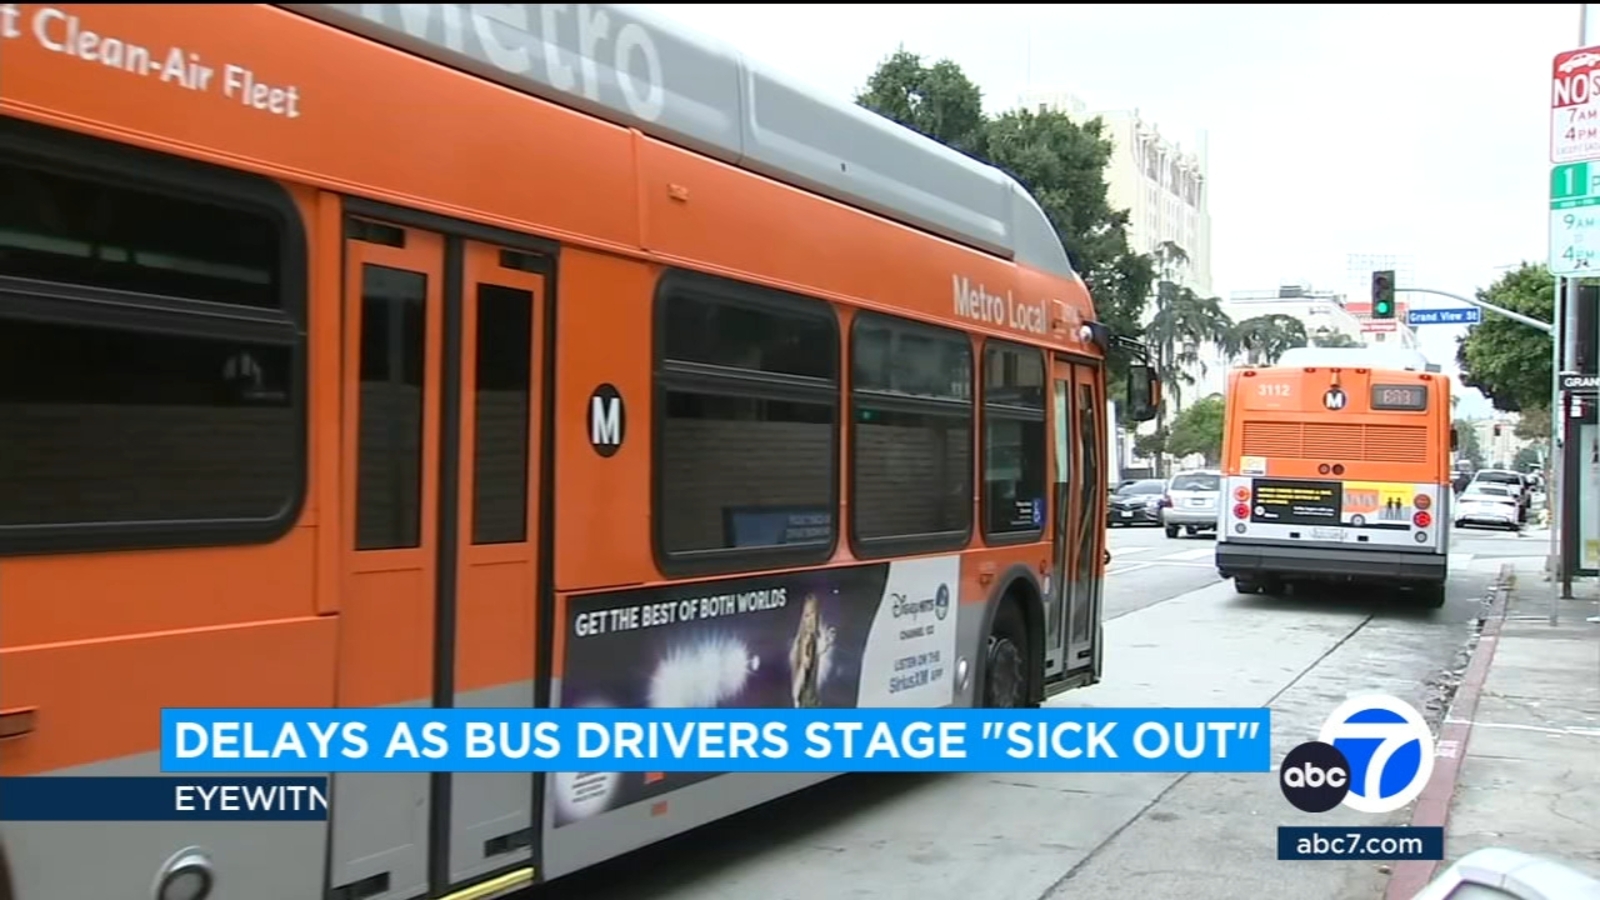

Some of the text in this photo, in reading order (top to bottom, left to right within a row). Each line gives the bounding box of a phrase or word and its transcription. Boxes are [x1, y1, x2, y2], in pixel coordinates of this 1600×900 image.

[32, 7, 214, 91] Clean-Air
[223, 63, 301, 118] Fleet
[1554, 73, 1589, 107] NO
[1563, 167, 1574, 196] 1
[952, 274, 1047, 335] Metro Local
[1409, 310, 1478, 323] Grand View St
[1257, 383, 1291, 397] 3112
[1325, 391, 1343, 409] M
[590, 393, 622, 447] M
[575, 588, 788, 636] GET THE BEST OF BOTH WORLDS
